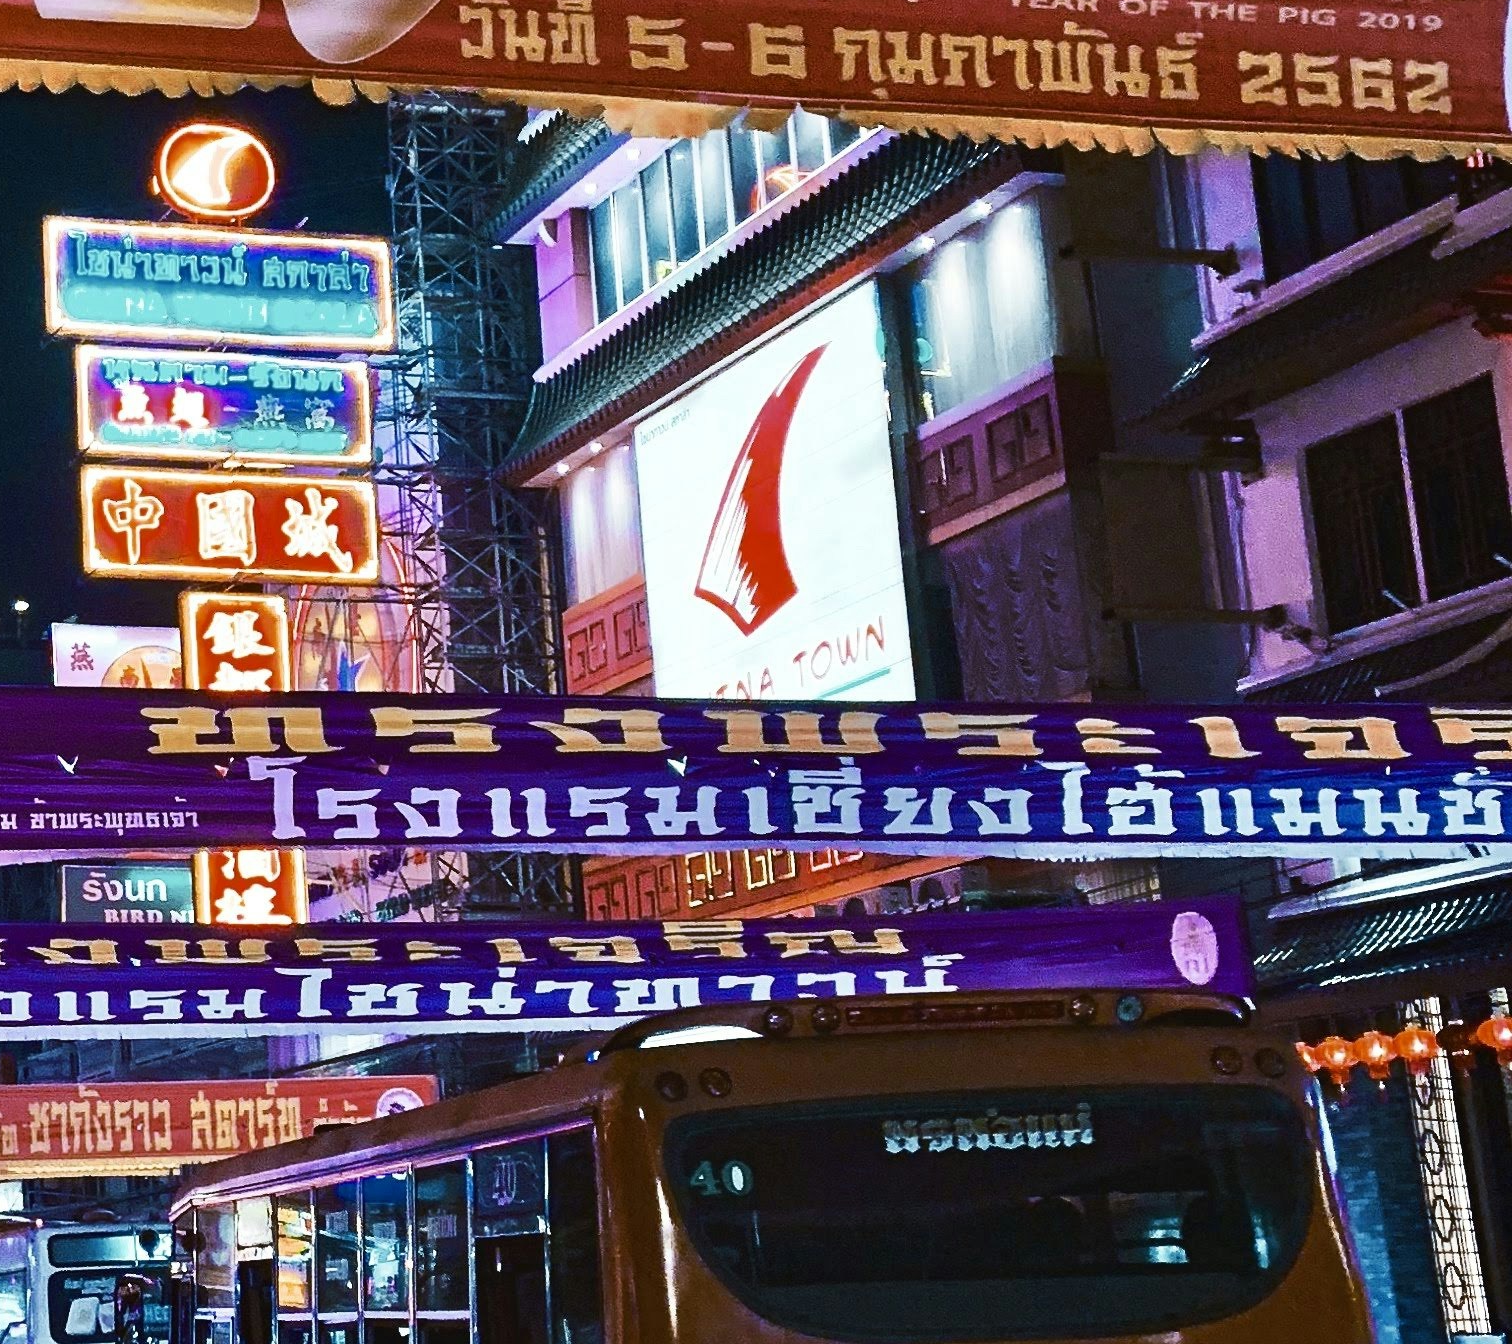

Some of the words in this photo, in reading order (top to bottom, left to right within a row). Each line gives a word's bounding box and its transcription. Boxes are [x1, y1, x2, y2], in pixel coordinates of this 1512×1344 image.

[1188, 0, 1257, 24] THE
[1278, 4, 1338, 28] PIG
[1358, 10, 1445, 34] 2019
[832, 20, 1204, 100] กุมภาพันธ์
[1238, 50, 1453, 114] 2562
[102, 479, 354, 574] 中國城
[793, 614, 886, 688] TOWN
[29, 796, 199, 839] ข้าพระพุทธเจ้า
[82, 870, 169, 904] รังนก
[104, 907, 167, 924] BIRD
[28, 1083, 173, 1154] ชากังราว
[688, 1159, 755, 1198] 40
